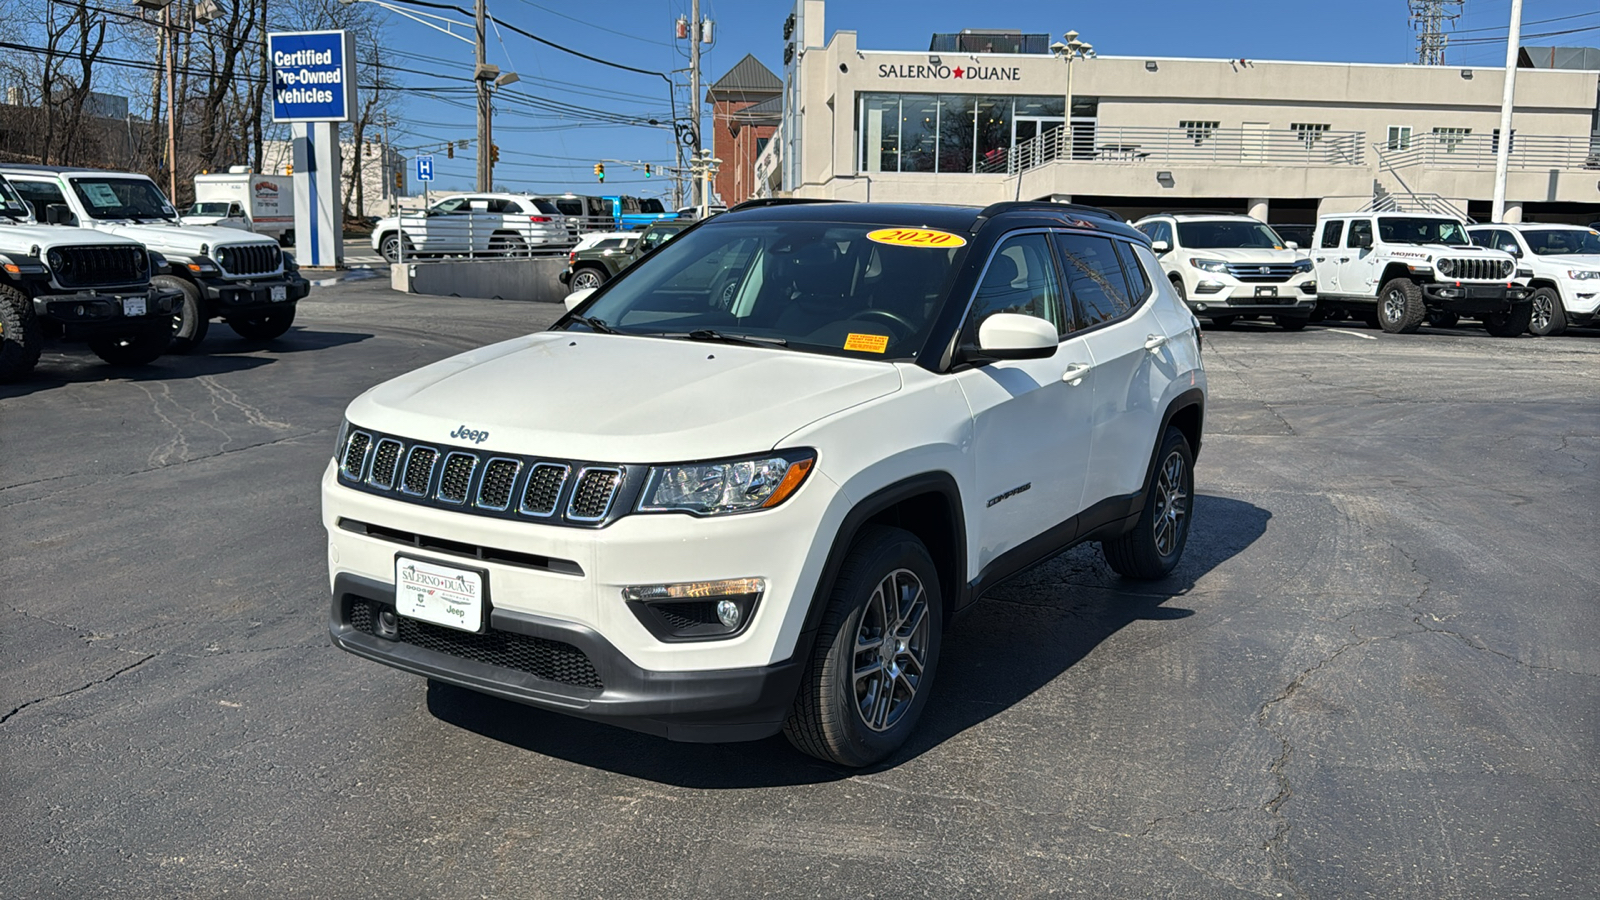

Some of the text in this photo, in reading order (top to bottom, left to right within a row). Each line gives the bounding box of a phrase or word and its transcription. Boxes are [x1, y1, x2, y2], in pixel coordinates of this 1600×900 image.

[274, 49, 332, 66] Certified
[275, 68, 341, 84] Pre-Owned
[879, 64, 1021, 80] SALERNO DUANE
[276, 87, 333, 104] Vehicles
[420, 161, 430, 174] H
[880, 231, 951, 243] 2020
[450, 424, 489, 444] Jeep
[986, 481, 1032, 508] COMPASS
[402, 570, 475, 594] SALERNO DUANE
[446, 605, 465, 618] Jeep
